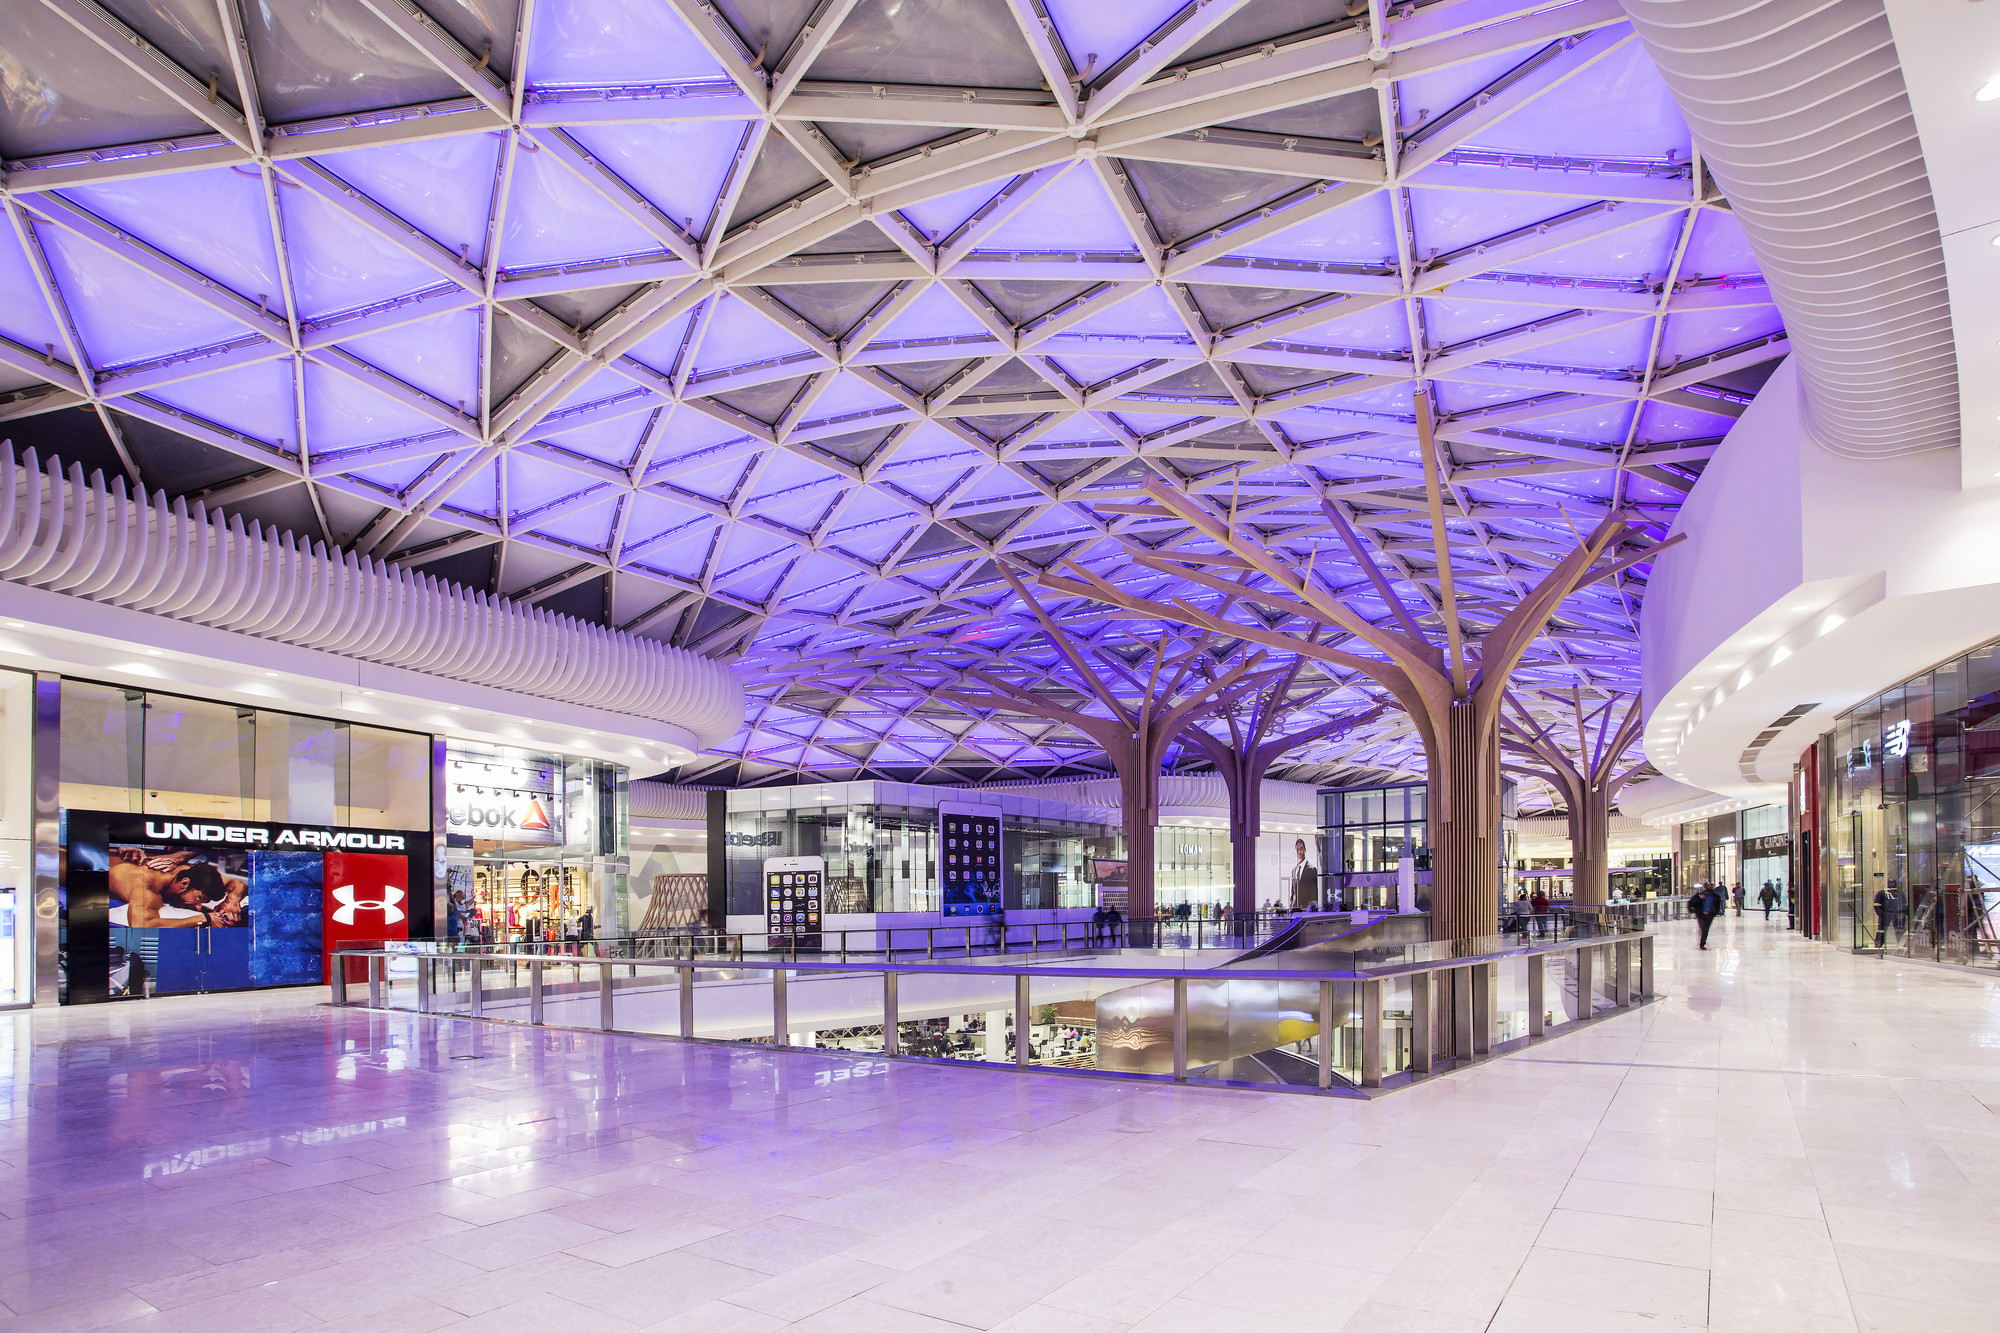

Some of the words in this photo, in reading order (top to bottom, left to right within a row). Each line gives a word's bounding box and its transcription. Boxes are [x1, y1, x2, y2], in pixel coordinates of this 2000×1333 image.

[446, 802, 517, 829] ebok
[145, 821, 269, 844] UNDER
[275, 829, 405, 850] ARMOUR
[1178, 844, 1203, 855] ROMAN
